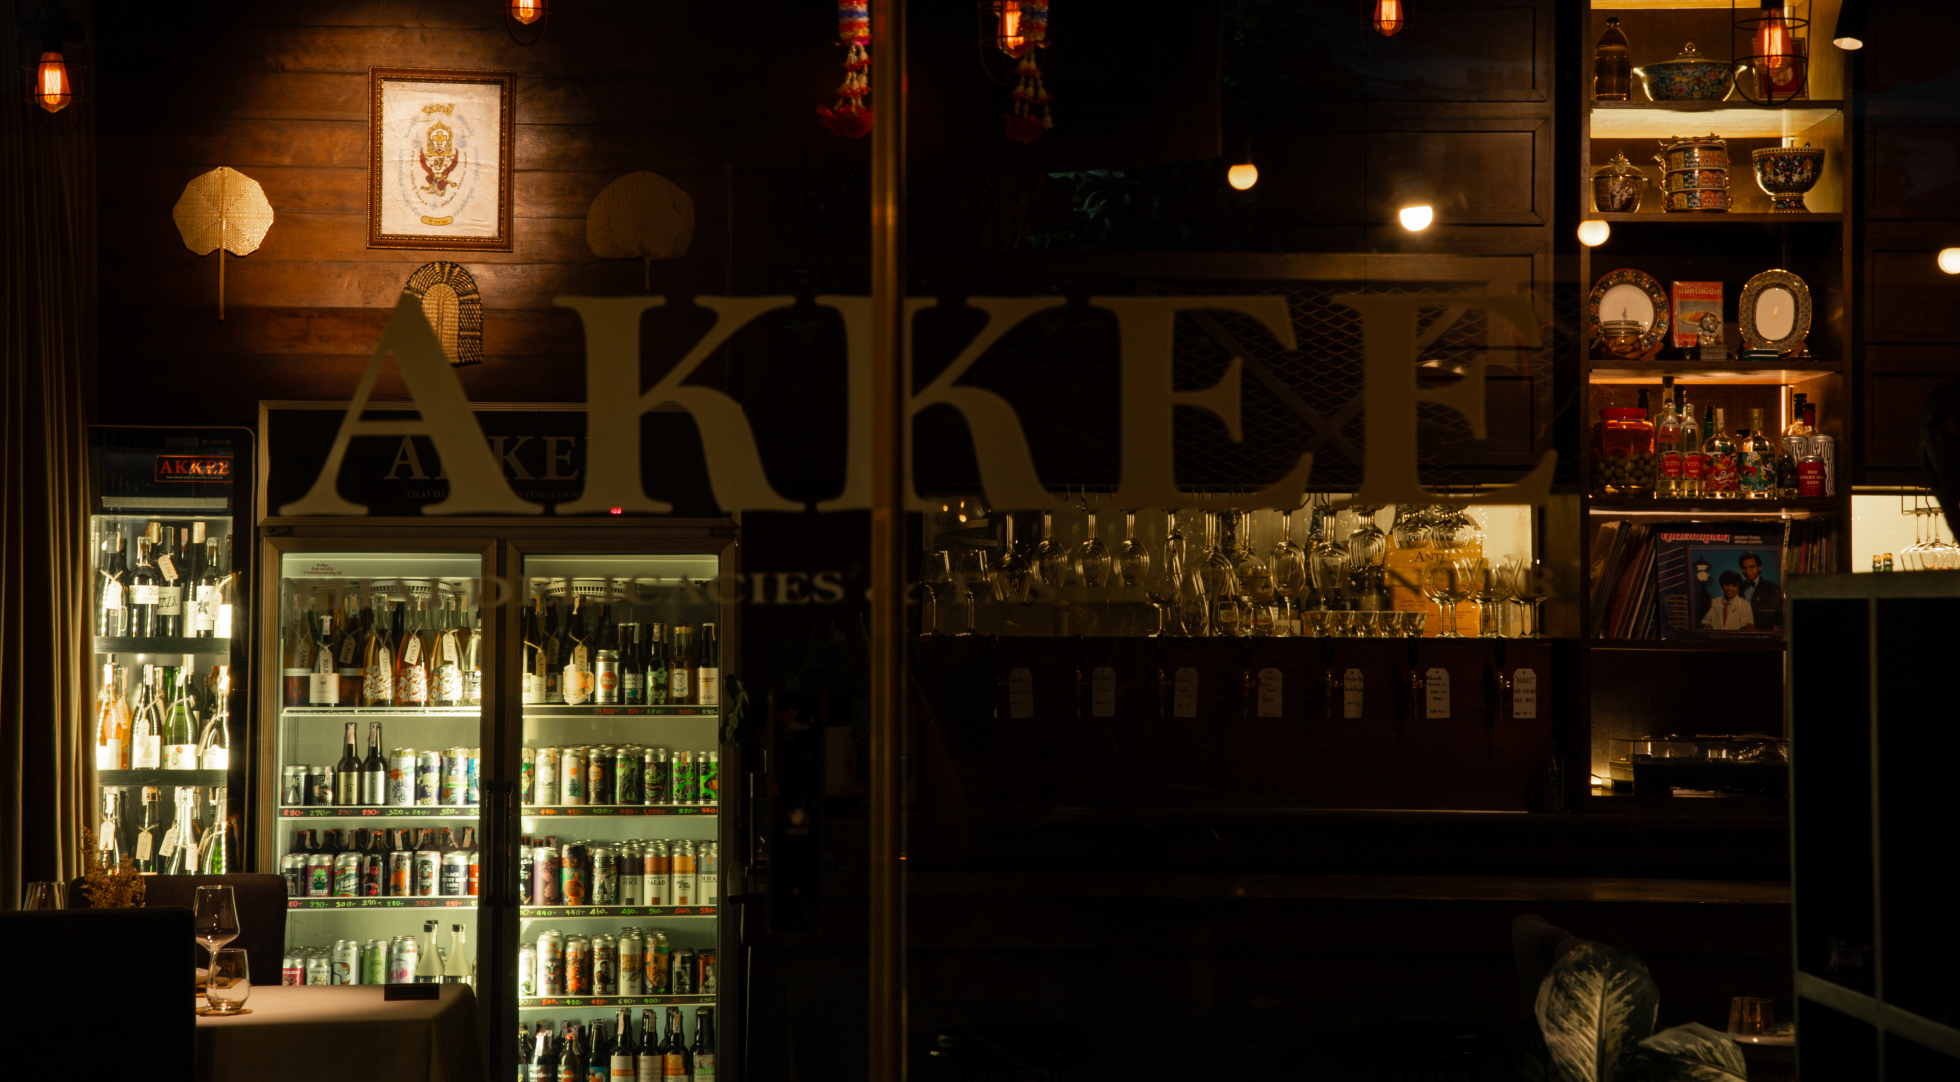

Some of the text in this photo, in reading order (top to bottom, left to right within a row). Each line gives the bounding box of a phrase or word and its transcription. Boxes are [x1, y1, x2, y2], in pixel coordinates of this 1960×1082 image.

[278, 293, 1557, 516] AKKEE
[159, 460, 231, 475] AKKEE
[405, 490, 431, 499] THAI
[472, 570, 845, 608] DELICACIES
